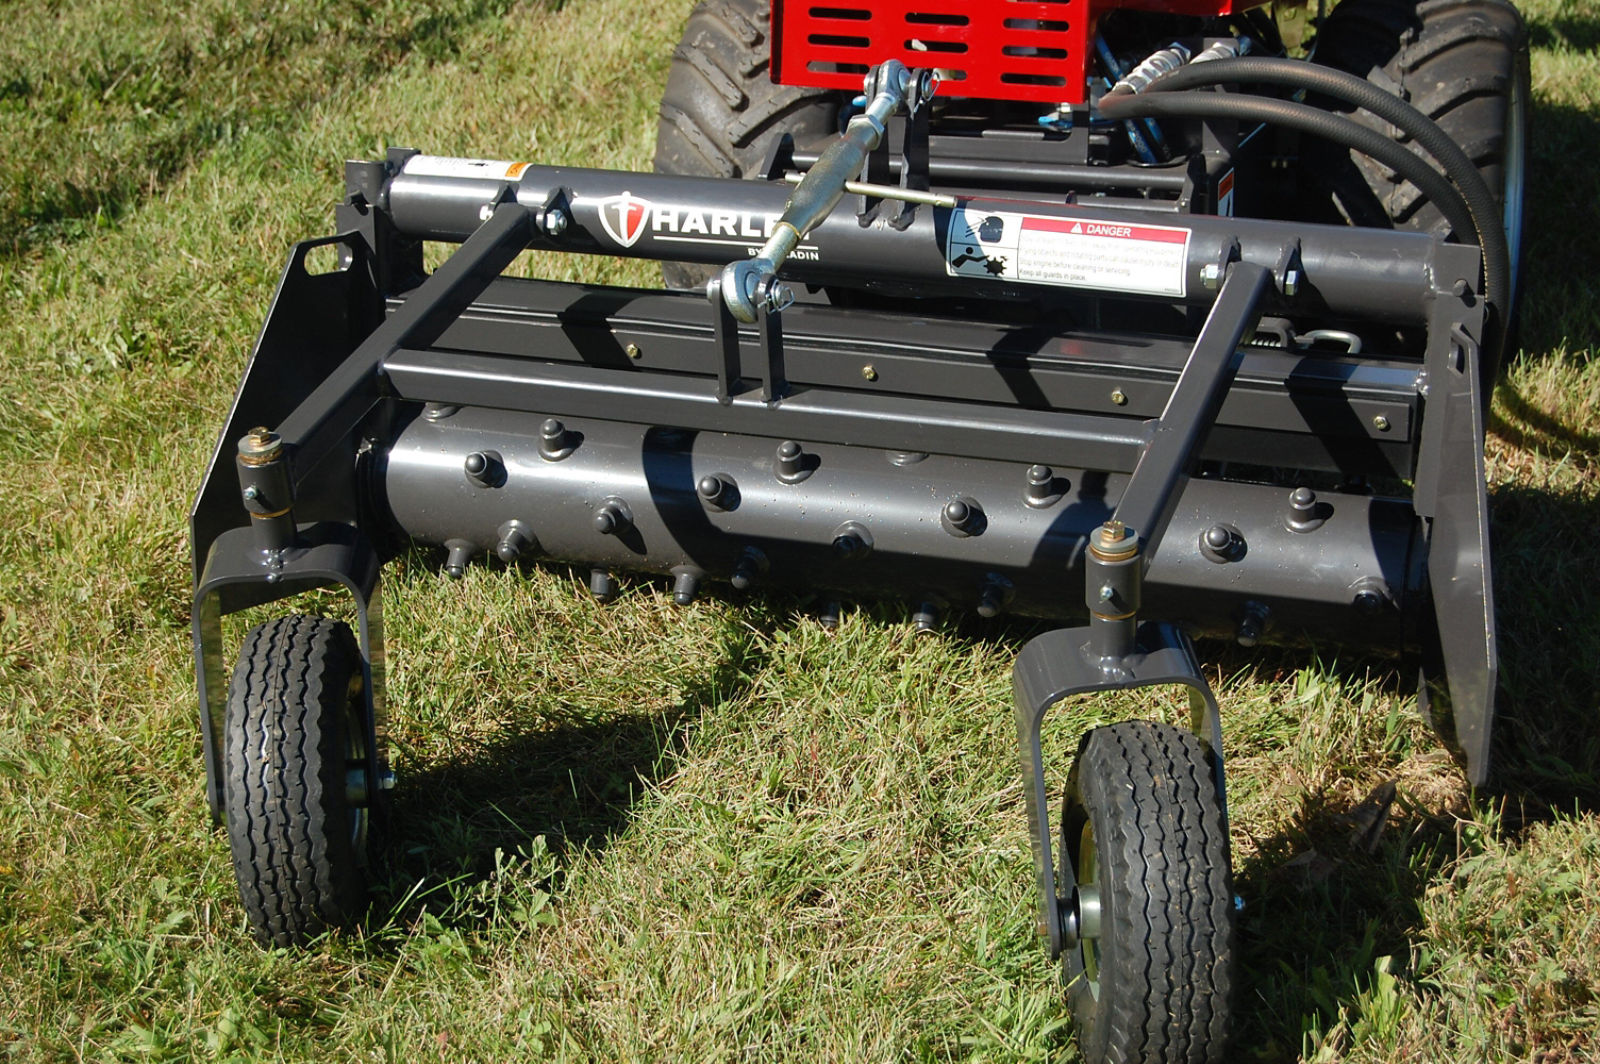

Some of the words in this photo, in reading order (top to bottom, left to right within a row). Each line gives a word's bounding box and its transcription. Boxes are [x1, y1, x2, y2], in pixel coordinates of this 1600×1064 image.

[651, 203, 810, 240] HARLE
[1086, 225, 1132, 237] DANGER
[1019, 269, 1034, 277] Keep
[1044, 271, 1063, 280] guards
